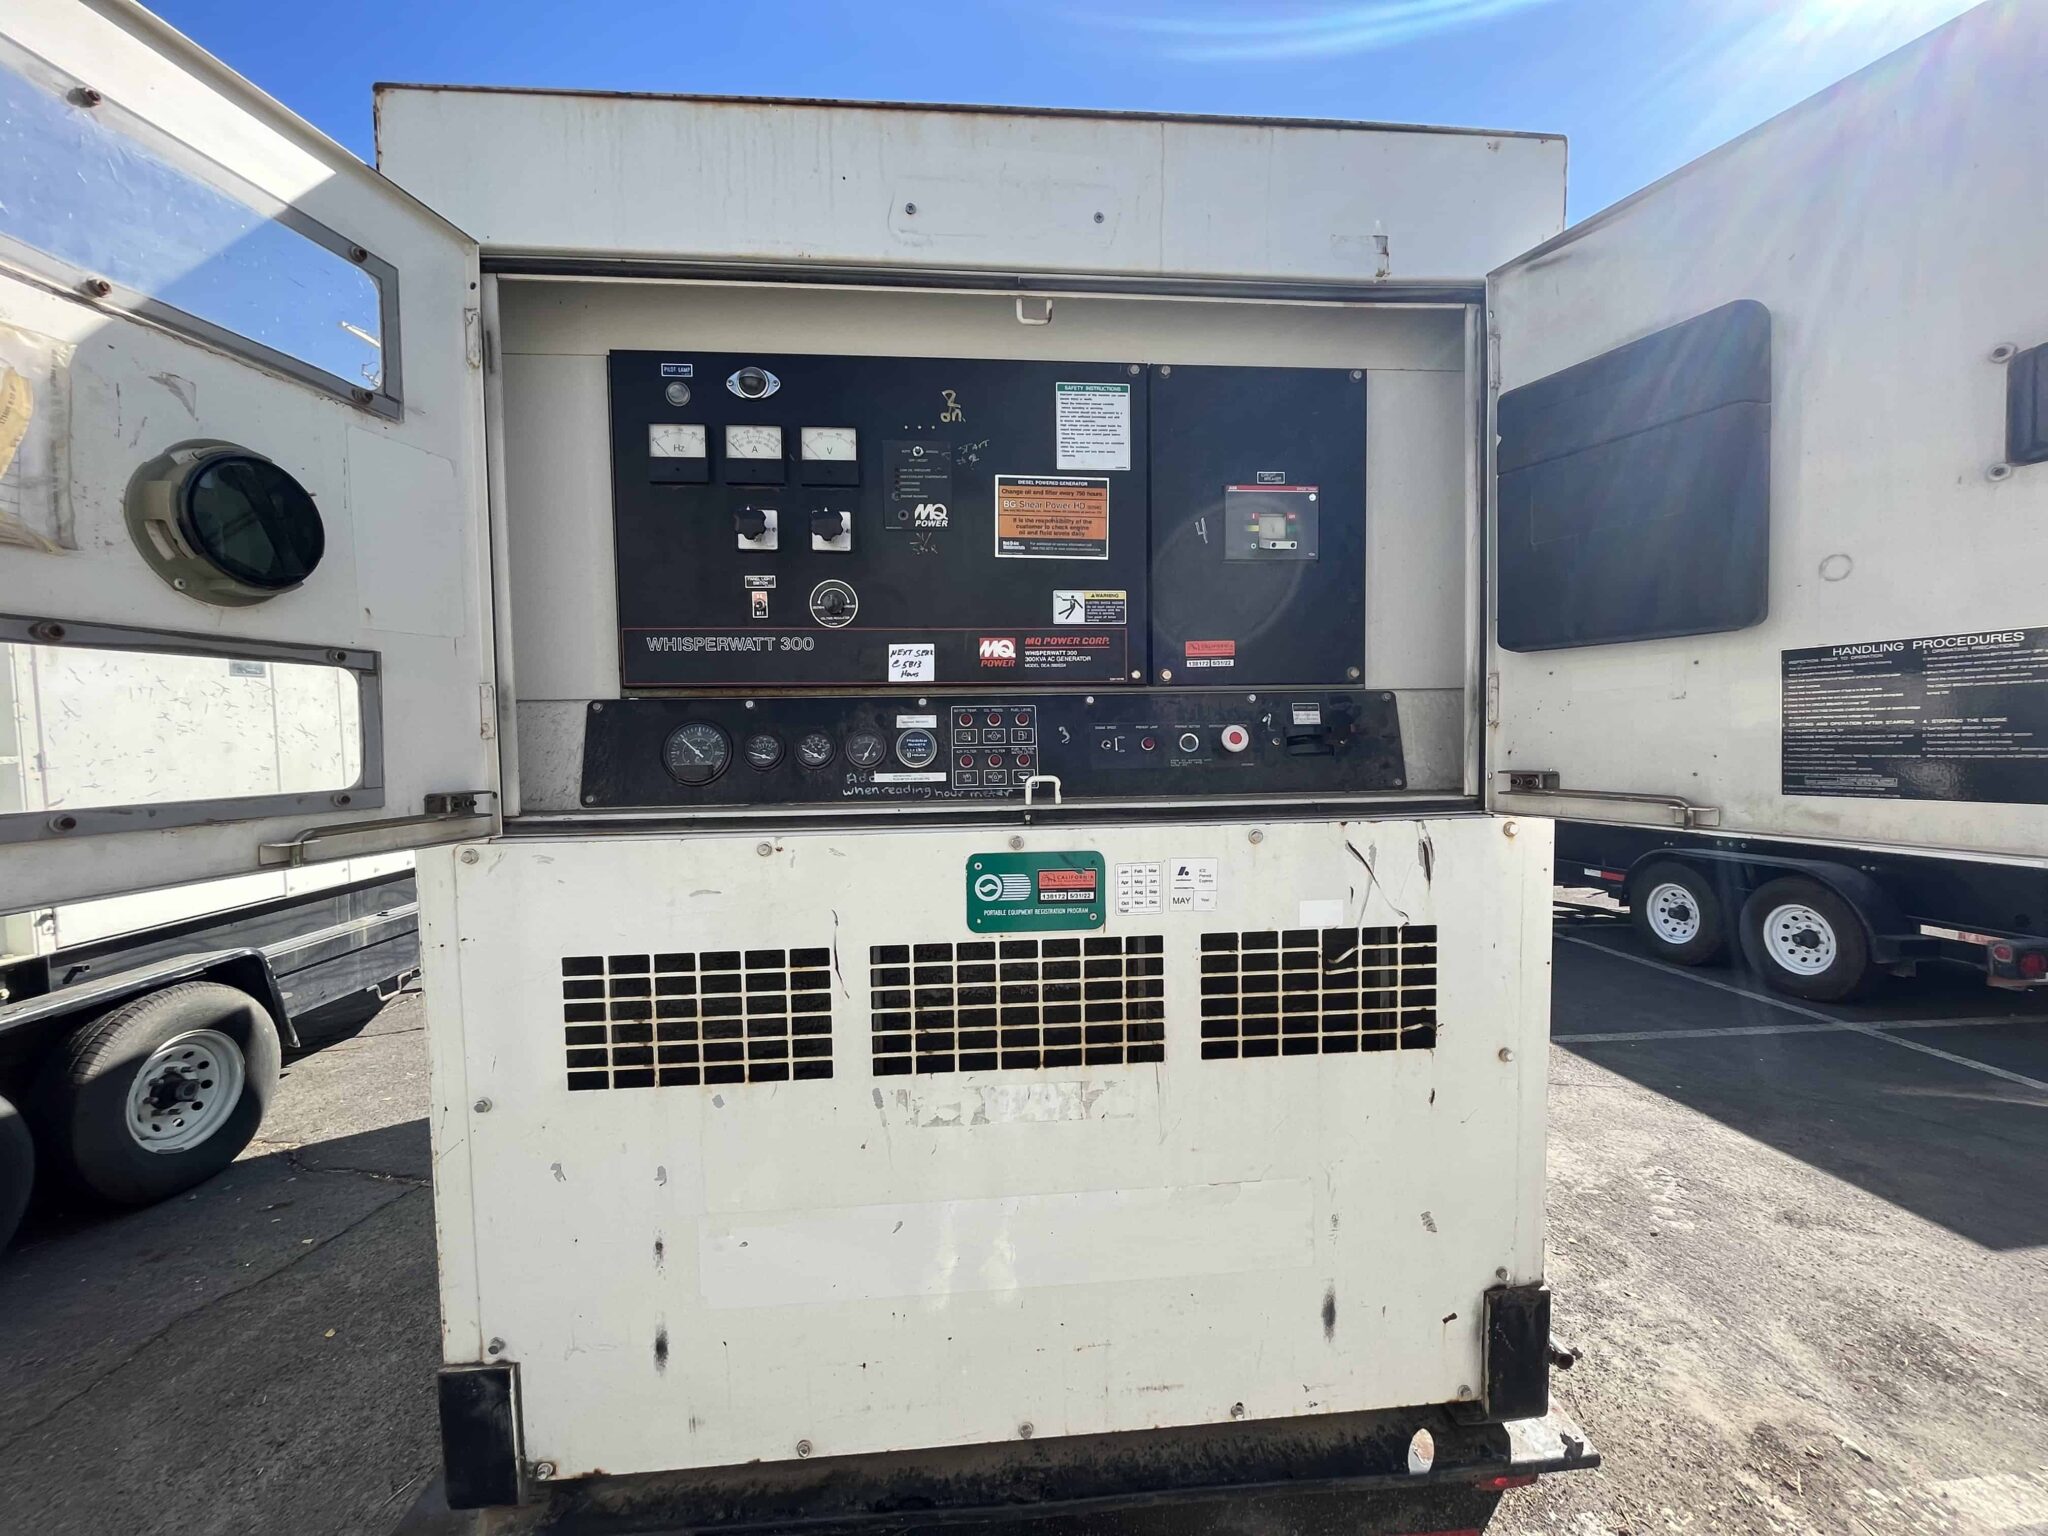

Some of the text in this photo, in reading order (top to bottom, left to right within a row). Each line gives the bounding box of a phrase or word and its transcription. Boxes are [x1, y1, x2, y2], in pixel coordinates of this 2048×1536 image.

[673, 444, 685, 452] Hz
[752, 445, 758, 453] A
[826, 447, 833, 455] V
[1003, 500, 1016, 508] BG
[1019, 500, 1042, 508] Shear
[1045, 501, 1071, 509] Power
[1073, 501, 1086, 509] HD
[914, 503, 949, 520] MQ
[1194, 517, 1209, 544] 4
[646, 636, 815, 652] WHISPERWATT 300
[1024, 637, 1110, 645] MQ POWER CORP.
[1832, 631, 2025, 656] HANDLING PROCEDURES
[890, 648, 913, 658] NEXT
[980, 640, 1016, 658] MQ
[842, 784, 1013, 799] when reading hour meter
[1172, 897, 1191, 905] MAY
[1007, 908, 1034, 916] EQUIPMENT
